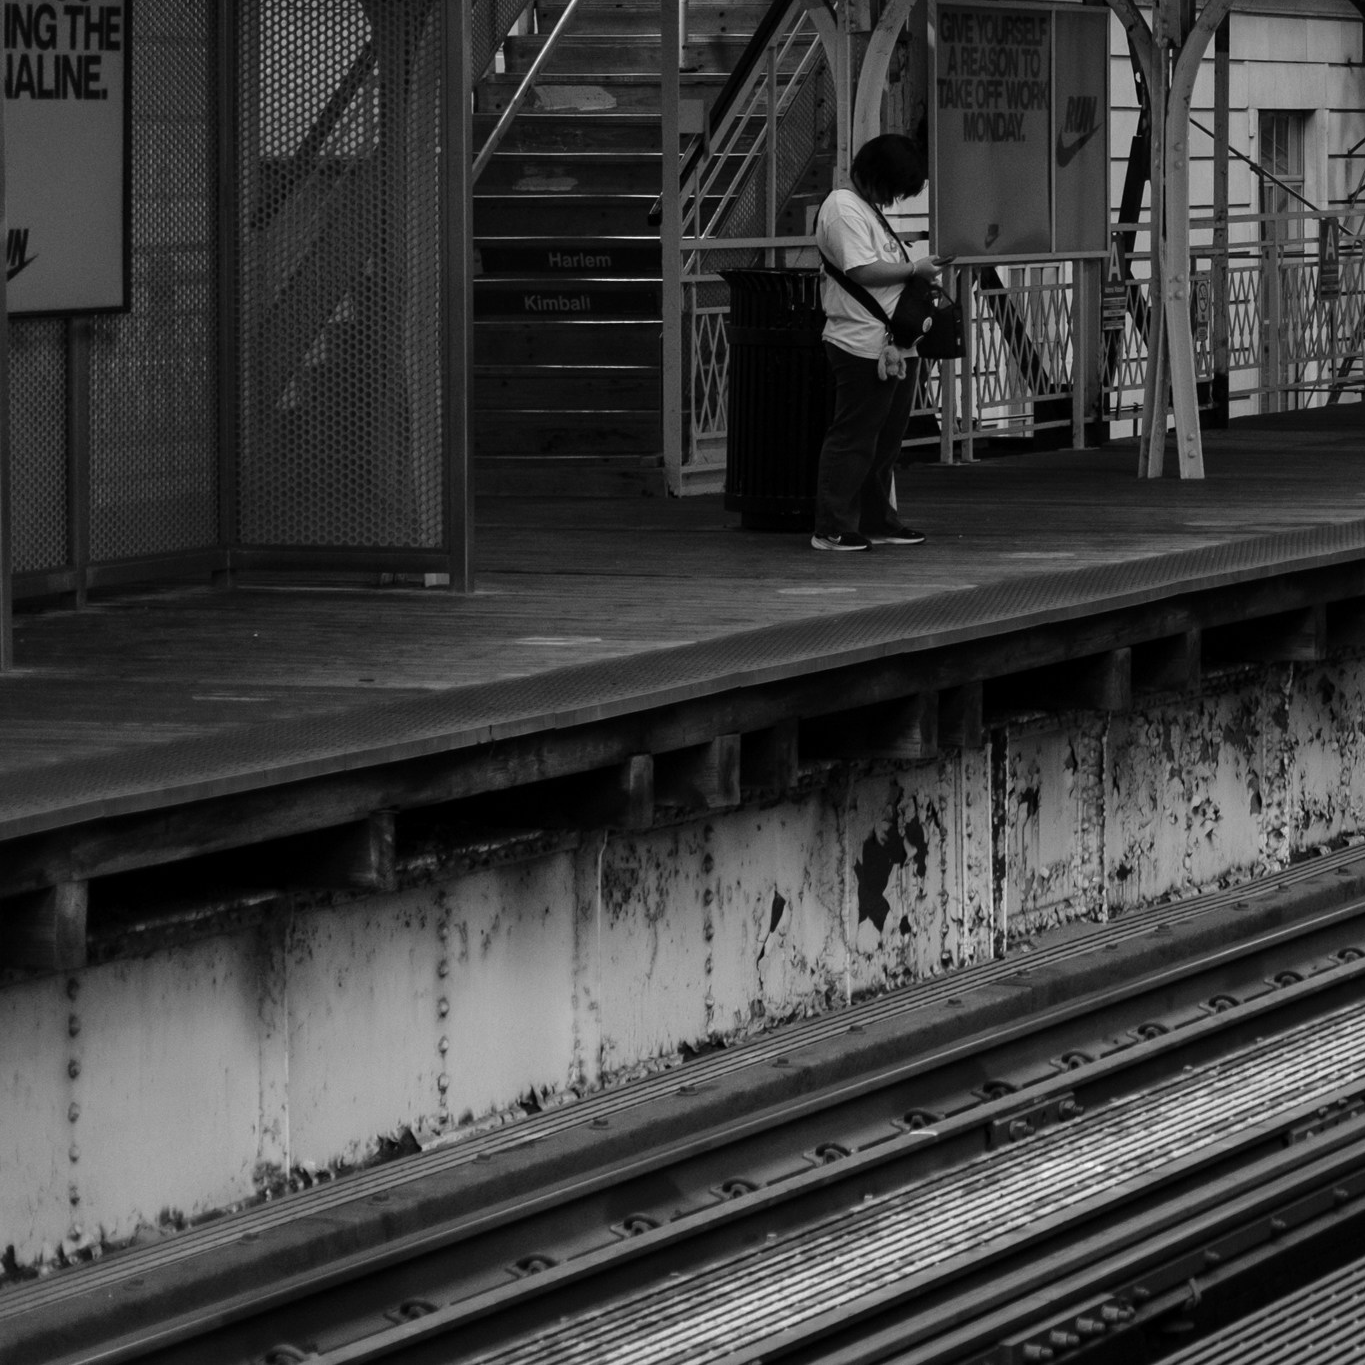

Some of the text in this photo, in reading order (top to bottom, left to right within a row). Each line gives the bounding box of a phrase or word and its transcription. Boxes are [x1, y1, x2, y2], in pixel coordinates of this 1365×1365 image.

[63, 5, 122, 51] THE
[940, 12, 1047, 46] GIVE YOURSELF
[947, 45, 1041, 78] A REASON TO
[937, 78, 1050, 110] TAKE OFF WORK
[963, 112, 1026, 142] MONDAY.
[1064, 96, 1097, 133] RUN
[1325, 225, 1336, 260] A
[548, 252, 612, 267] Harlem
[1108, 242, 1122, 282] A
[524, 295, 591, 311] Kimball
